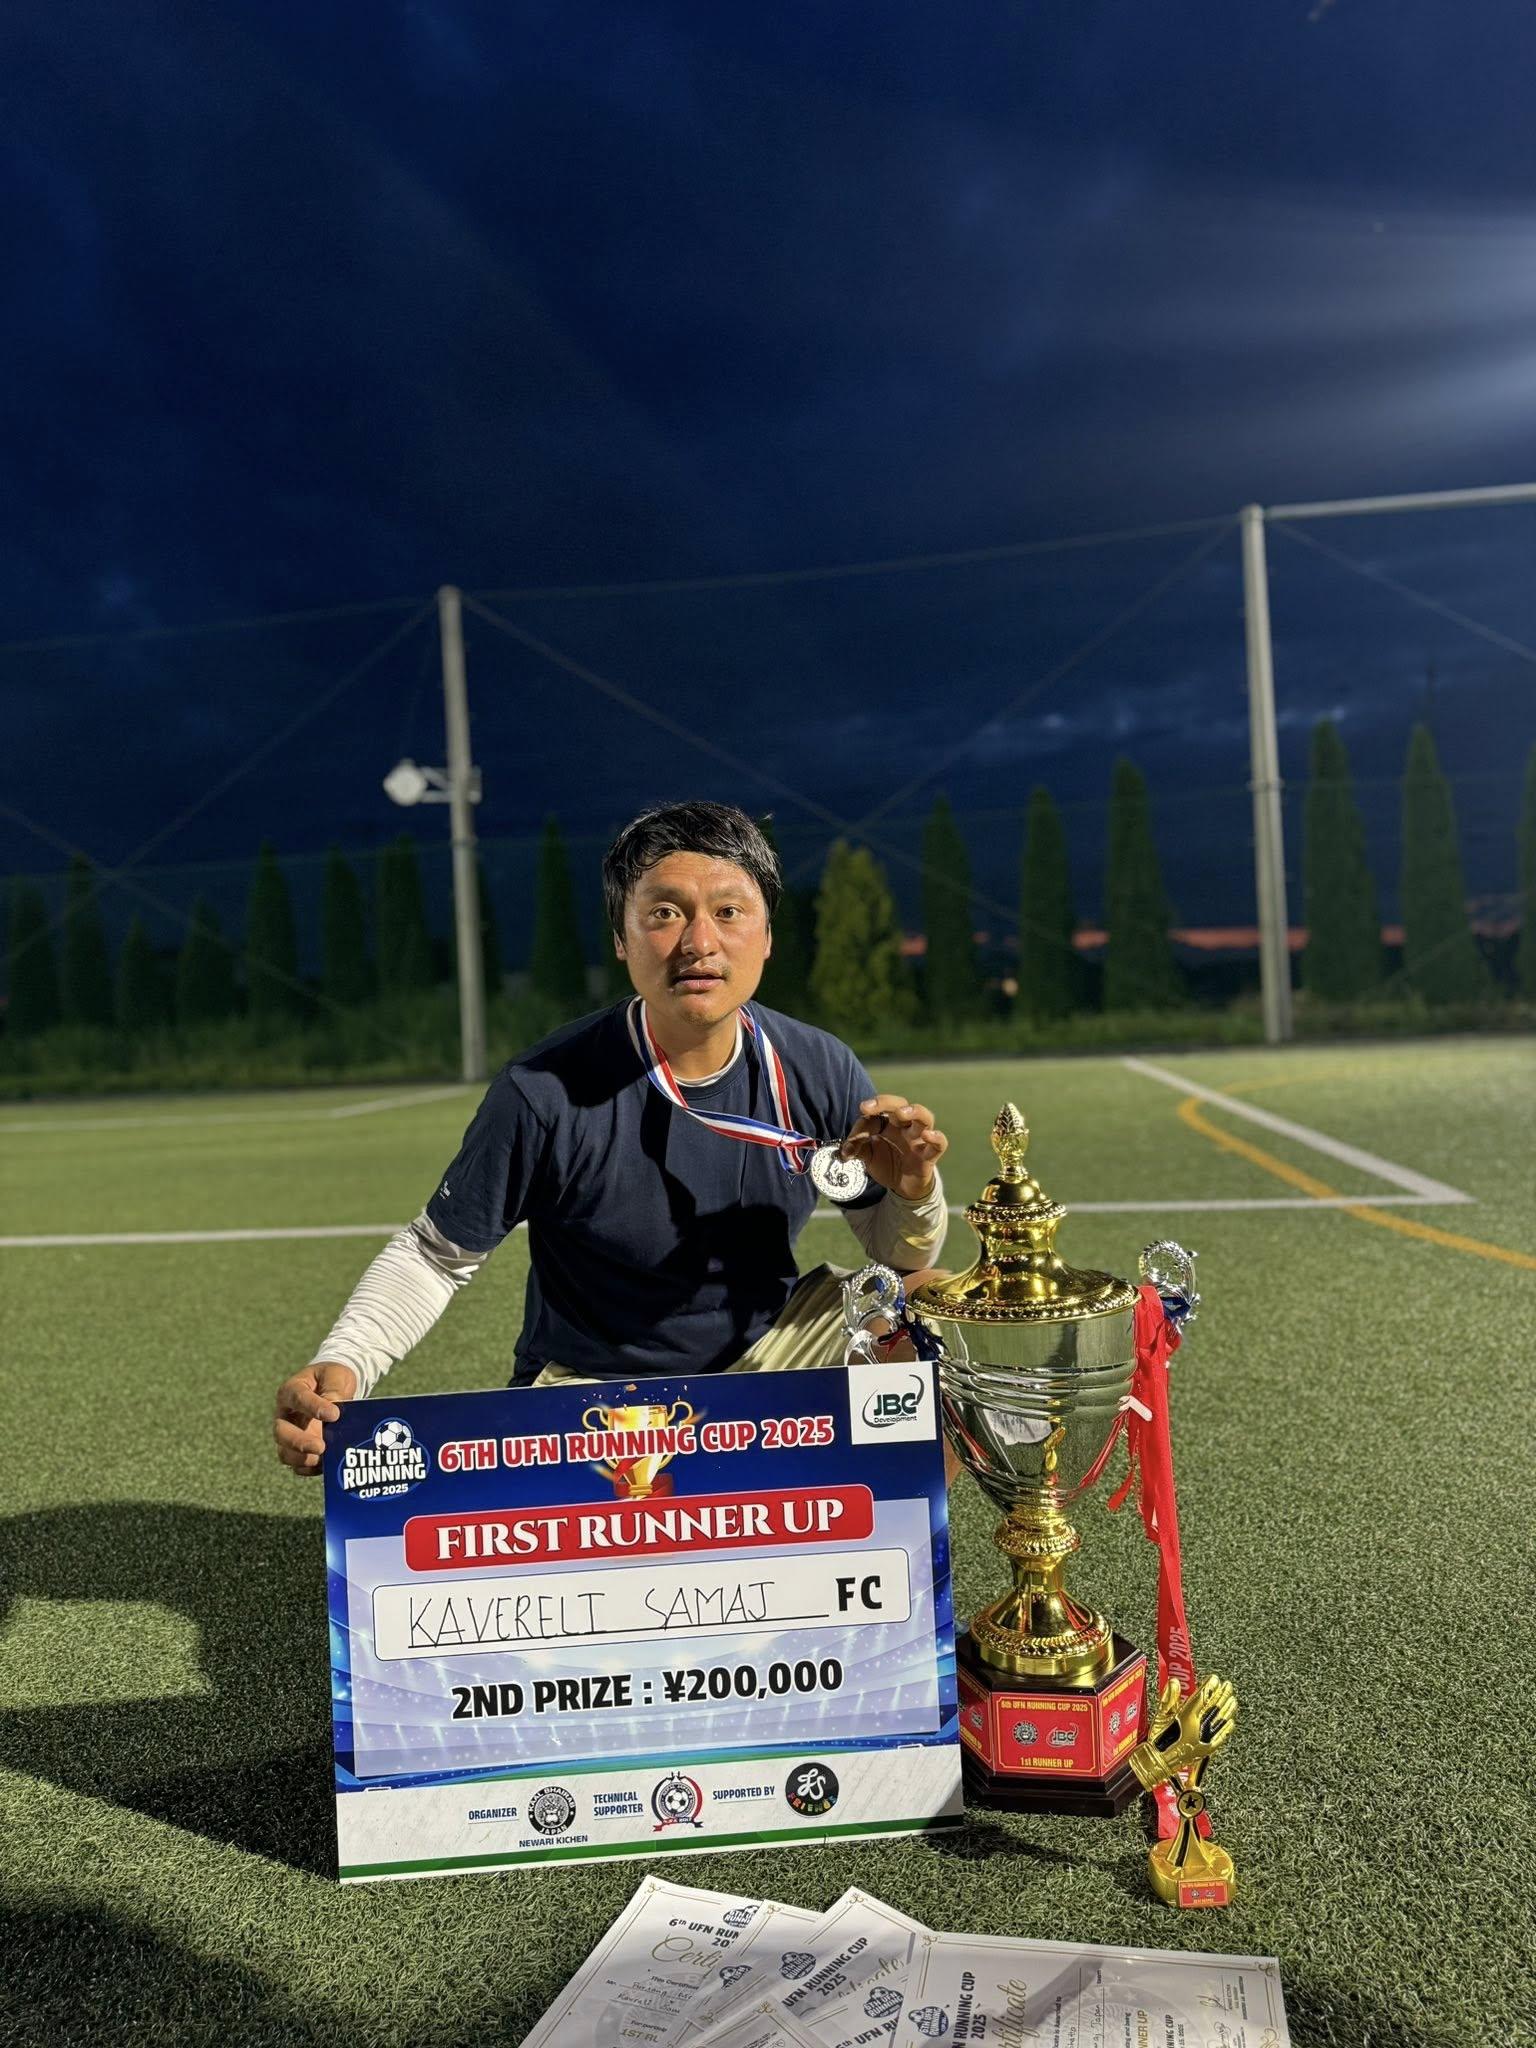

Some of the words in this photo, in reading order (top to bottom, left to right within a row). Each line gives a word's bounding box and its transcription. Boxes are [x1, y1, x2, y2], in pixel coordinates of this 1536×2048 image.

[873, 1392, 917, 1416] JBC
[873, 1415, 918, 1424] Development
[439, 1440, 497, 1471] 6TH
[504, 1435, 559, 1467] UFN
[566, 1425, 696, 1462] RUNNING
[702, 1421, 756, 1451] CUP
[762, 1416, 834, 1448] 2025
[345, 1447, 381, 1468] 6TH
[386, 1447, 422, 1465] UFN
[343, 1463, 426, 1490] RUNNING
[359, 1487, 381, 1499] CUP
[382, 1483, 409, 1496] 2025
[436, 1517, 568, 1560] FIRST
[578, 1503, 775, 1550] RUNNER
[782, 1499, 844, 1533] UP
[835, 1575, 883, 1612] FC
[644, 1581, 776, 1631] SAMAJ
[451, 1683, 524, 1719] 2ND
[532, 1674, 633, 1713] PRIZE
[662, 1658, 843, 1703] ¥200,000
[1027, 1701, 1056, 1711] RUNNING
[1057, 1702, 1071, 1711] CUP
[1071, 1703, 1088, 1712] 2025
[1020, 1757, 1032, 1766] 1st
[1032, 1757, 1063, 1768] RUNNER
[1063, 1759, 1074, 1769] UP
[593, 1791, 639, 1804] TECHNICAL
[712, 1787, 762, 1801] SUPPORTED
[763, 1785, 775, 1796] BY
[468, 1807, 518, 1820] ORGANIZER
[593, 1803, 644, 1817] SUPPORTER
[519, 1837, 555, 1848] NEWARI
[556, 1834, 589, 1845] KICHEN
[688, 1922, 714, 1934] UFN
[782, 1988, 808, 2007] UFN
[803, 1953, 852, 1991] RUNNING
[847, 1937, 868, 1955] CUP
[961, 1971, 976, 1992] CUP
[817, 1972, 848, 1997] 2025
[953, 1994, 973, 2039] RUNNING
[971, 2014, 987, 2039] 2025
[1137, 2010, 1148, 2023] UP
[854, 2027, 883, 2045] UFN
